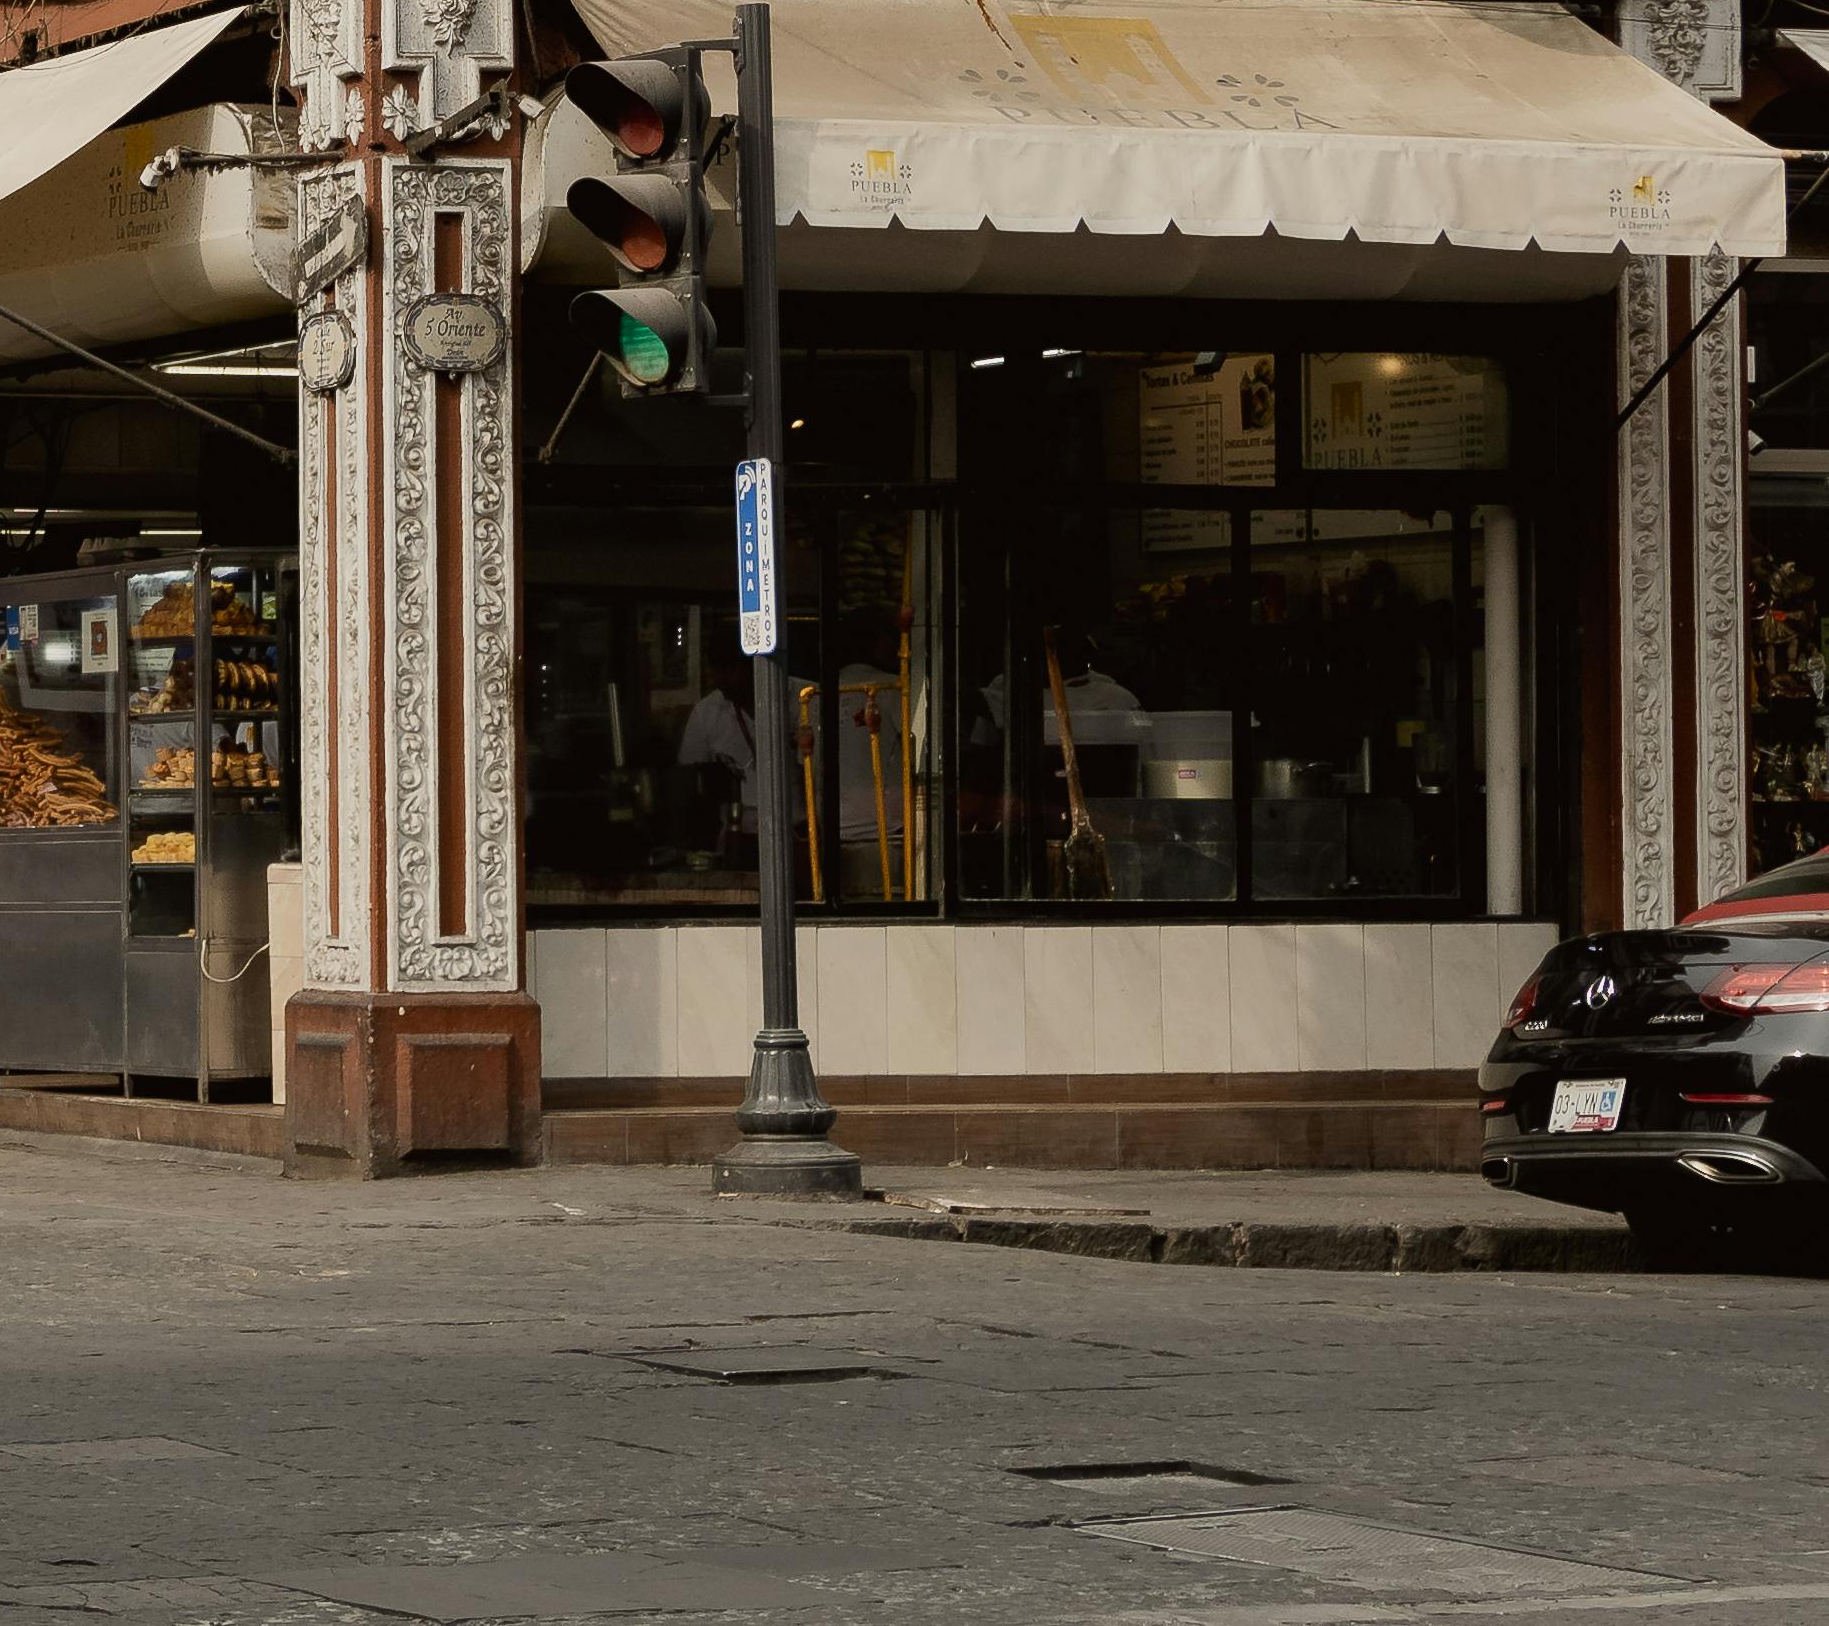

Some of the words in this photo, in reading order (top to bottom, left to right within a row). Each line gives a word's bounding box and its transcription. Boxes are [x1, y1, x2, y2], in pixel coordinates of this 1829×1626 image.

[990, 105, 1344, 131] PUEBLA
[852, 180, 912, 195] PUEBLA
[108, 189, 170, 219] PUEBLA
[1609, 206, 1670, 220] PUEBLA
[425, 317, 435, 336] 5
[437, 320, 486, 337] Oriente
[312, 339, 318, 355] 2
[1313, 447, 1382, 469] PUEBLA
[744, 522, 755, 592] ZONA
[759, 463, 772, 648] PARQUÍMETROS
[1555, 1092, 1599, 1116] 03-LYN
